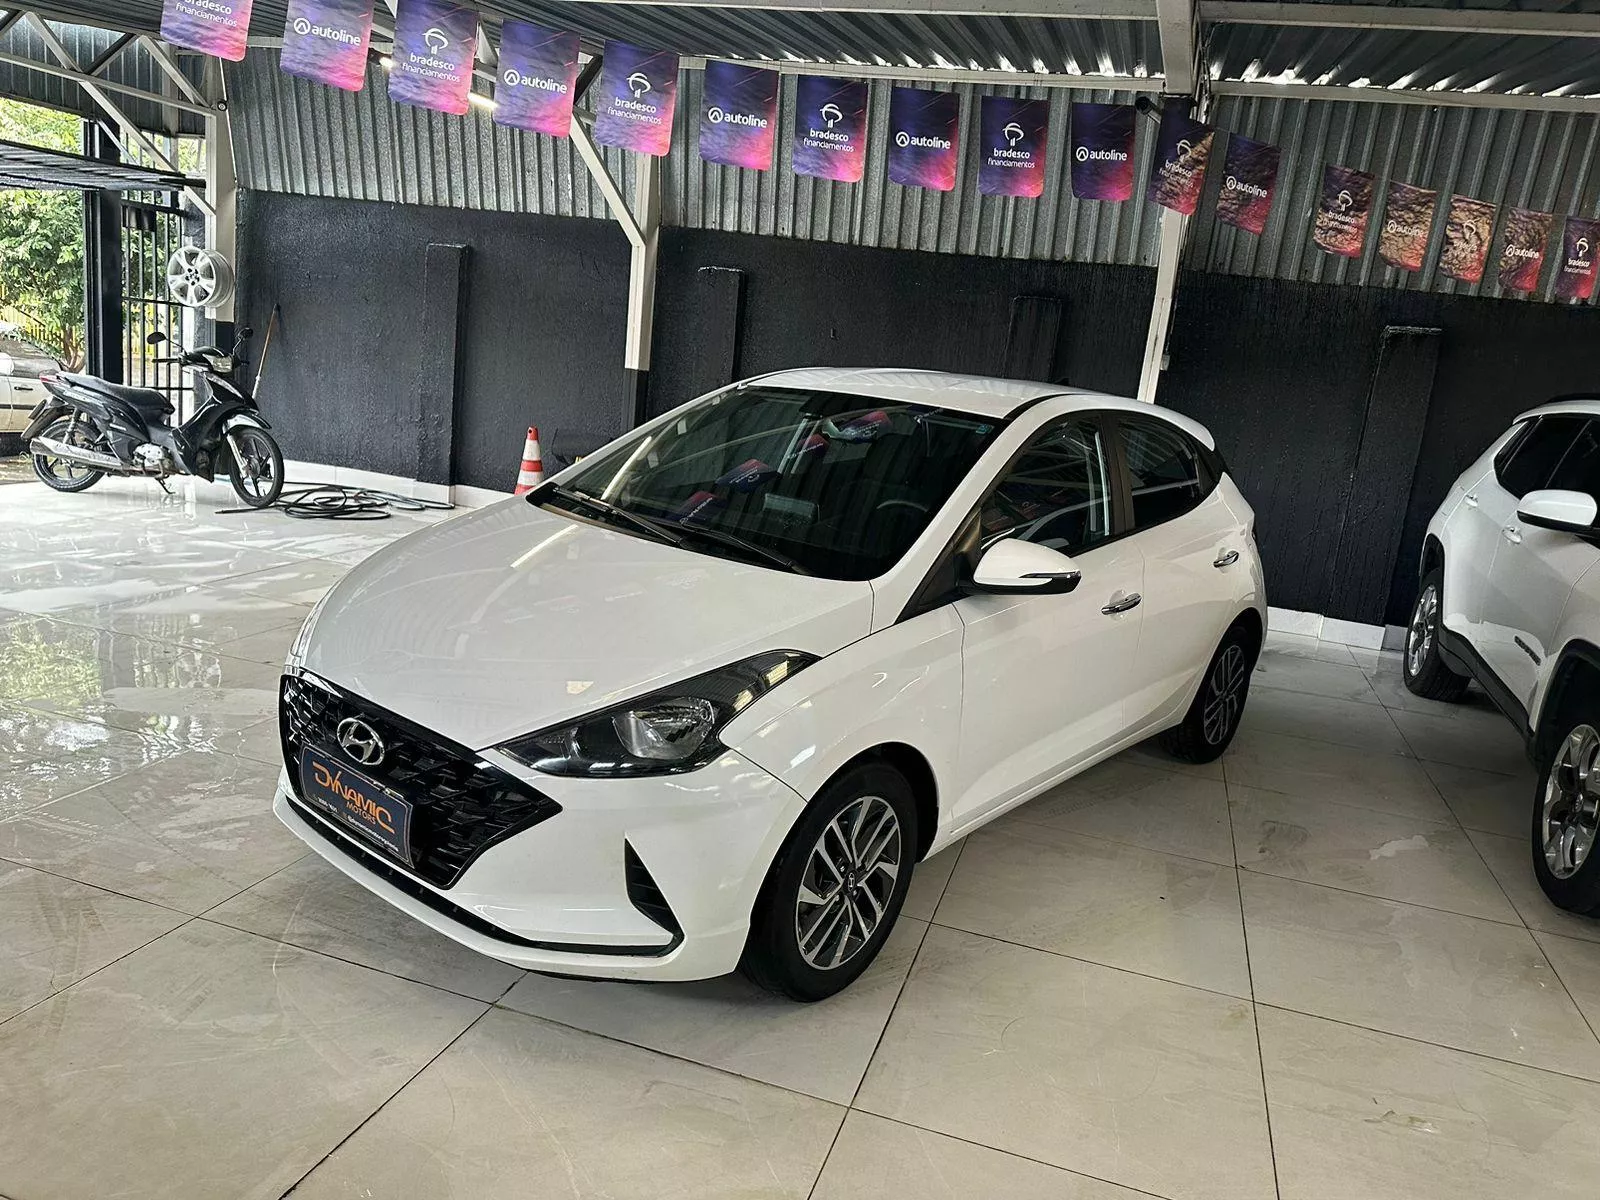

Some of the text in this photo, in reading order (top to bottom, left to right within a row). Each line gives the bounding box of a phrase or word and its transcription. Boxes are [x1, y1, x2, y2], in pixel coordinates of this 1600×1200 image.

[175, 2, 238, 27] financiamentos
[311, 24, 362, 47] autoline
[409, 52, 455, 71] bradesco
[401, 62, 461, 83] financiamentos
[521, 75, 568, 94] autoline
[615, 97, 657, 114] bradesco
[607, 106, 662, 125] financiamentos
[724, 112, 768, 129] autoline
[809, 127, 849, 142] bradesco
[911, 136, 951, 149] autoline
[803, 137, 854, 153] financiamentos
[993, 148, 1031, 159] bradesco
[987, 157, 1035, 169] financiamentos
[1089, 149, 1128, 161] autoline
[1236, 181, 1268, 198] autoline
[312, 761, 396, 834] DYNAMIC
[346, 801, 376, 825] MOTORS
